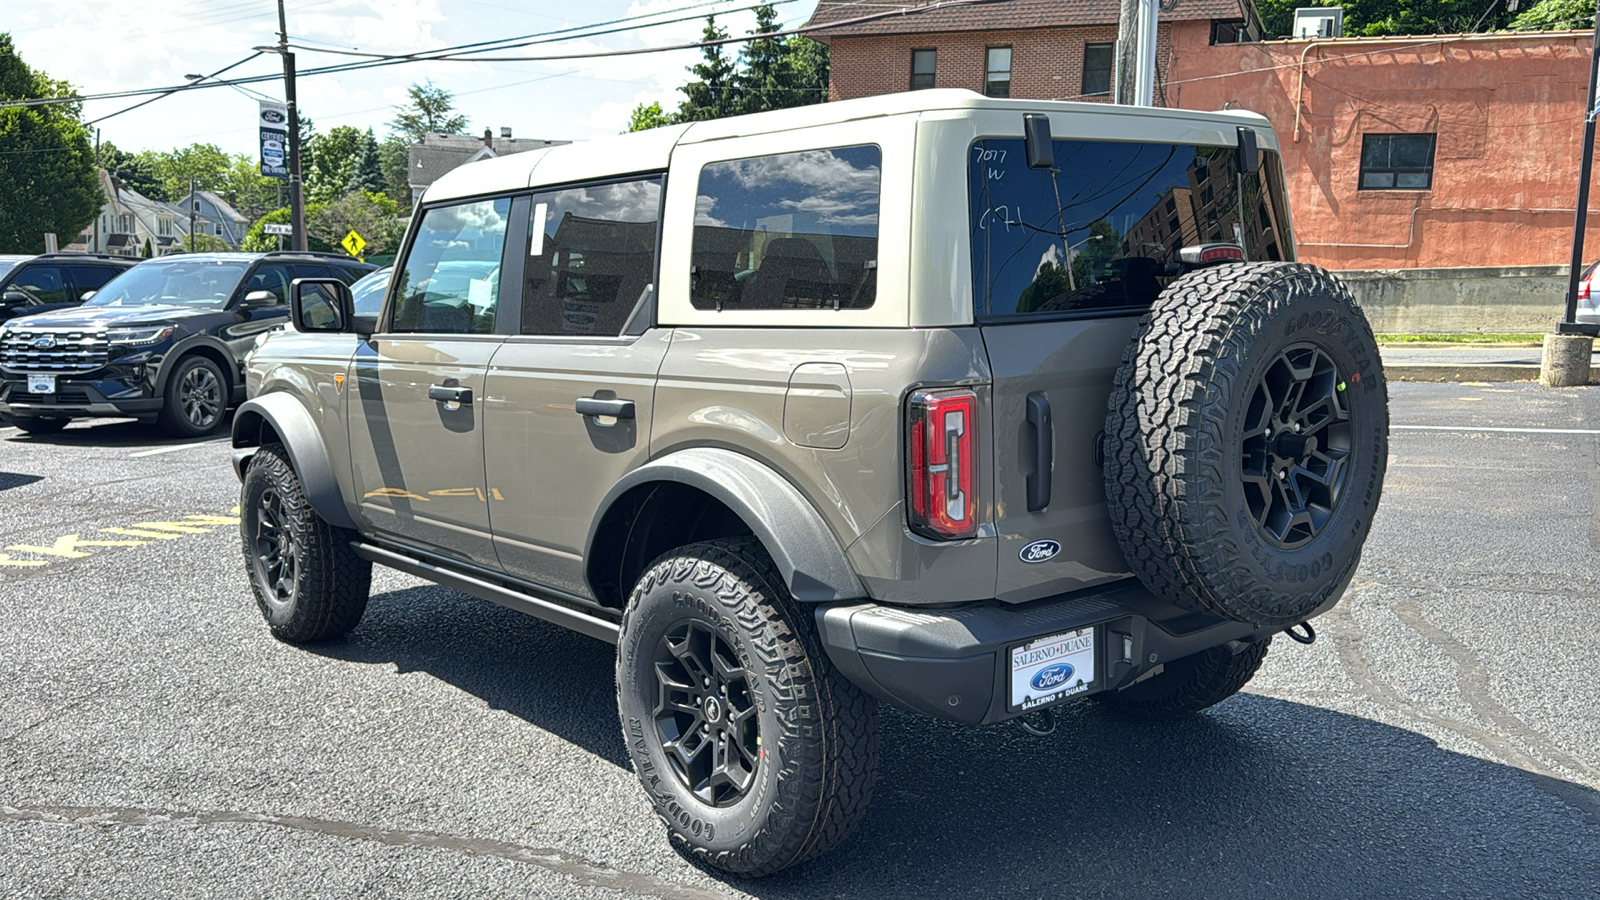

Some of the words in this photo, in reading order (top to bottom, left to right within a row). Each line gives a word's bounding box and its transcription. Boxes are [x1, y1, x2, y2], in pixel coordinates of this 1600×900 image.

[265, 111, 281, 122] Ford
[261, 131, 285, 143] CERTIFIED
[974, 146, 1007, 163] 7077
[267, 225, 283, 233] Park
[1363, 426, 1382, 511] TERRITORY
[1027, 543, 1055, 560] Ford
[1013, 646, 1056, 668] SALERNO
[1059, 636, 1092, 655] DUANE
[1038, 667, 1067, 688] Ford
[1021, 694, 1056, 710] SALERNO
[1065, 683, 1089, 697] DUANE
[629, 716, 716, 841] GOODYEAR
